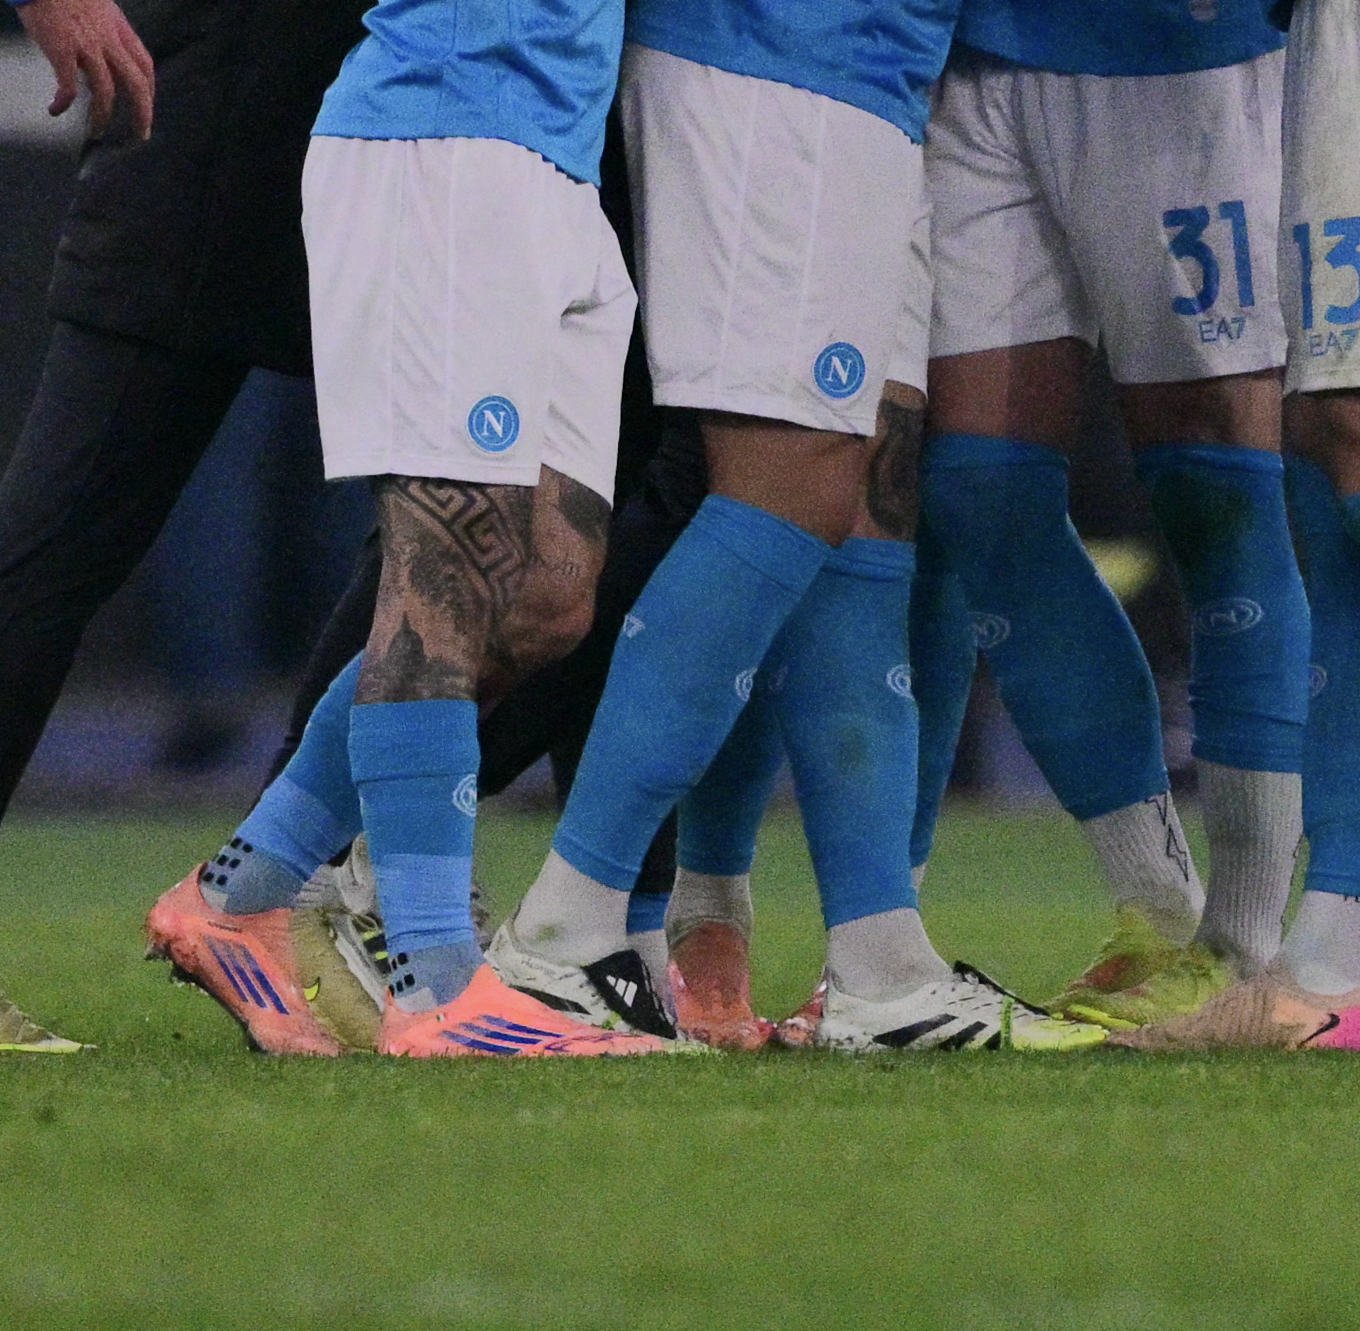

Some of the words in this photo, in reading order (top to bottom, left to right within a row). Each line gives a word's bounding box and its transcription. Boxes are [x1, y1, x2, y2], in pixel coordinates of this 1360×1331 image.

[1162, 199, 1256, 317] 31
[1198, 316, 1247, 344] EA7
[1309, 328, 1360, 357] EA7
[824, 355, 853, 386] N
[480, 409, 507, 439] N
